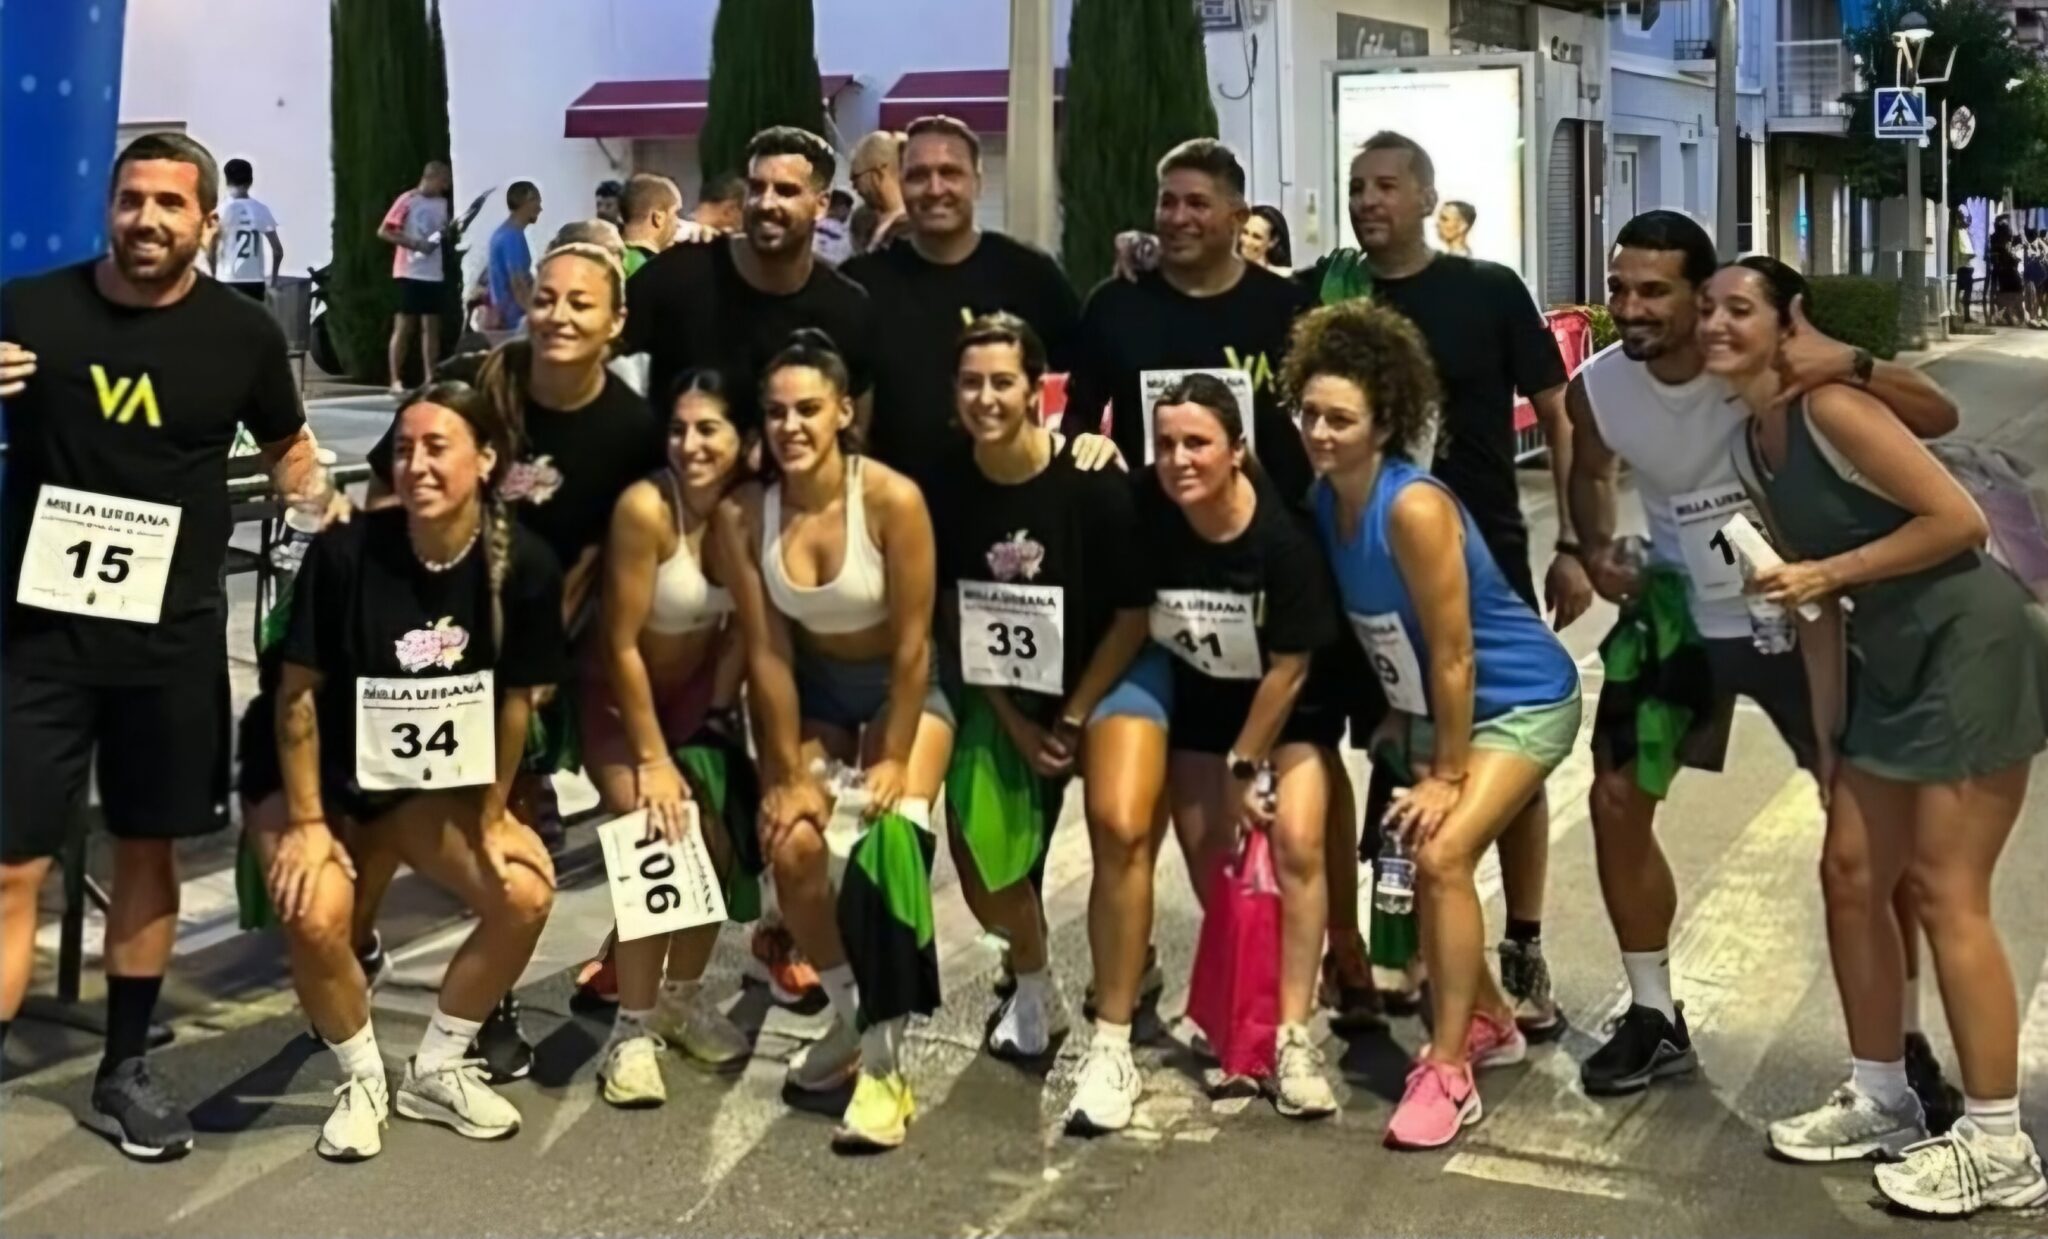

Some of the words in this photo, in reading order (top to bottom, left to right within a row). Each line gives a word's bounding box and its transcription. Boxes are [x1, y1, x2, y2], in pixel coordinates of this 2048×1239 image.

[236, 229, 260, 259] 21
[90, 364, 162, 428] VA
[65, 539, 134, 584] 15
[986, 622, 1037, 660] 33
[390, 719, 459, 759] 34
[634, 826, 681, 914] 106
